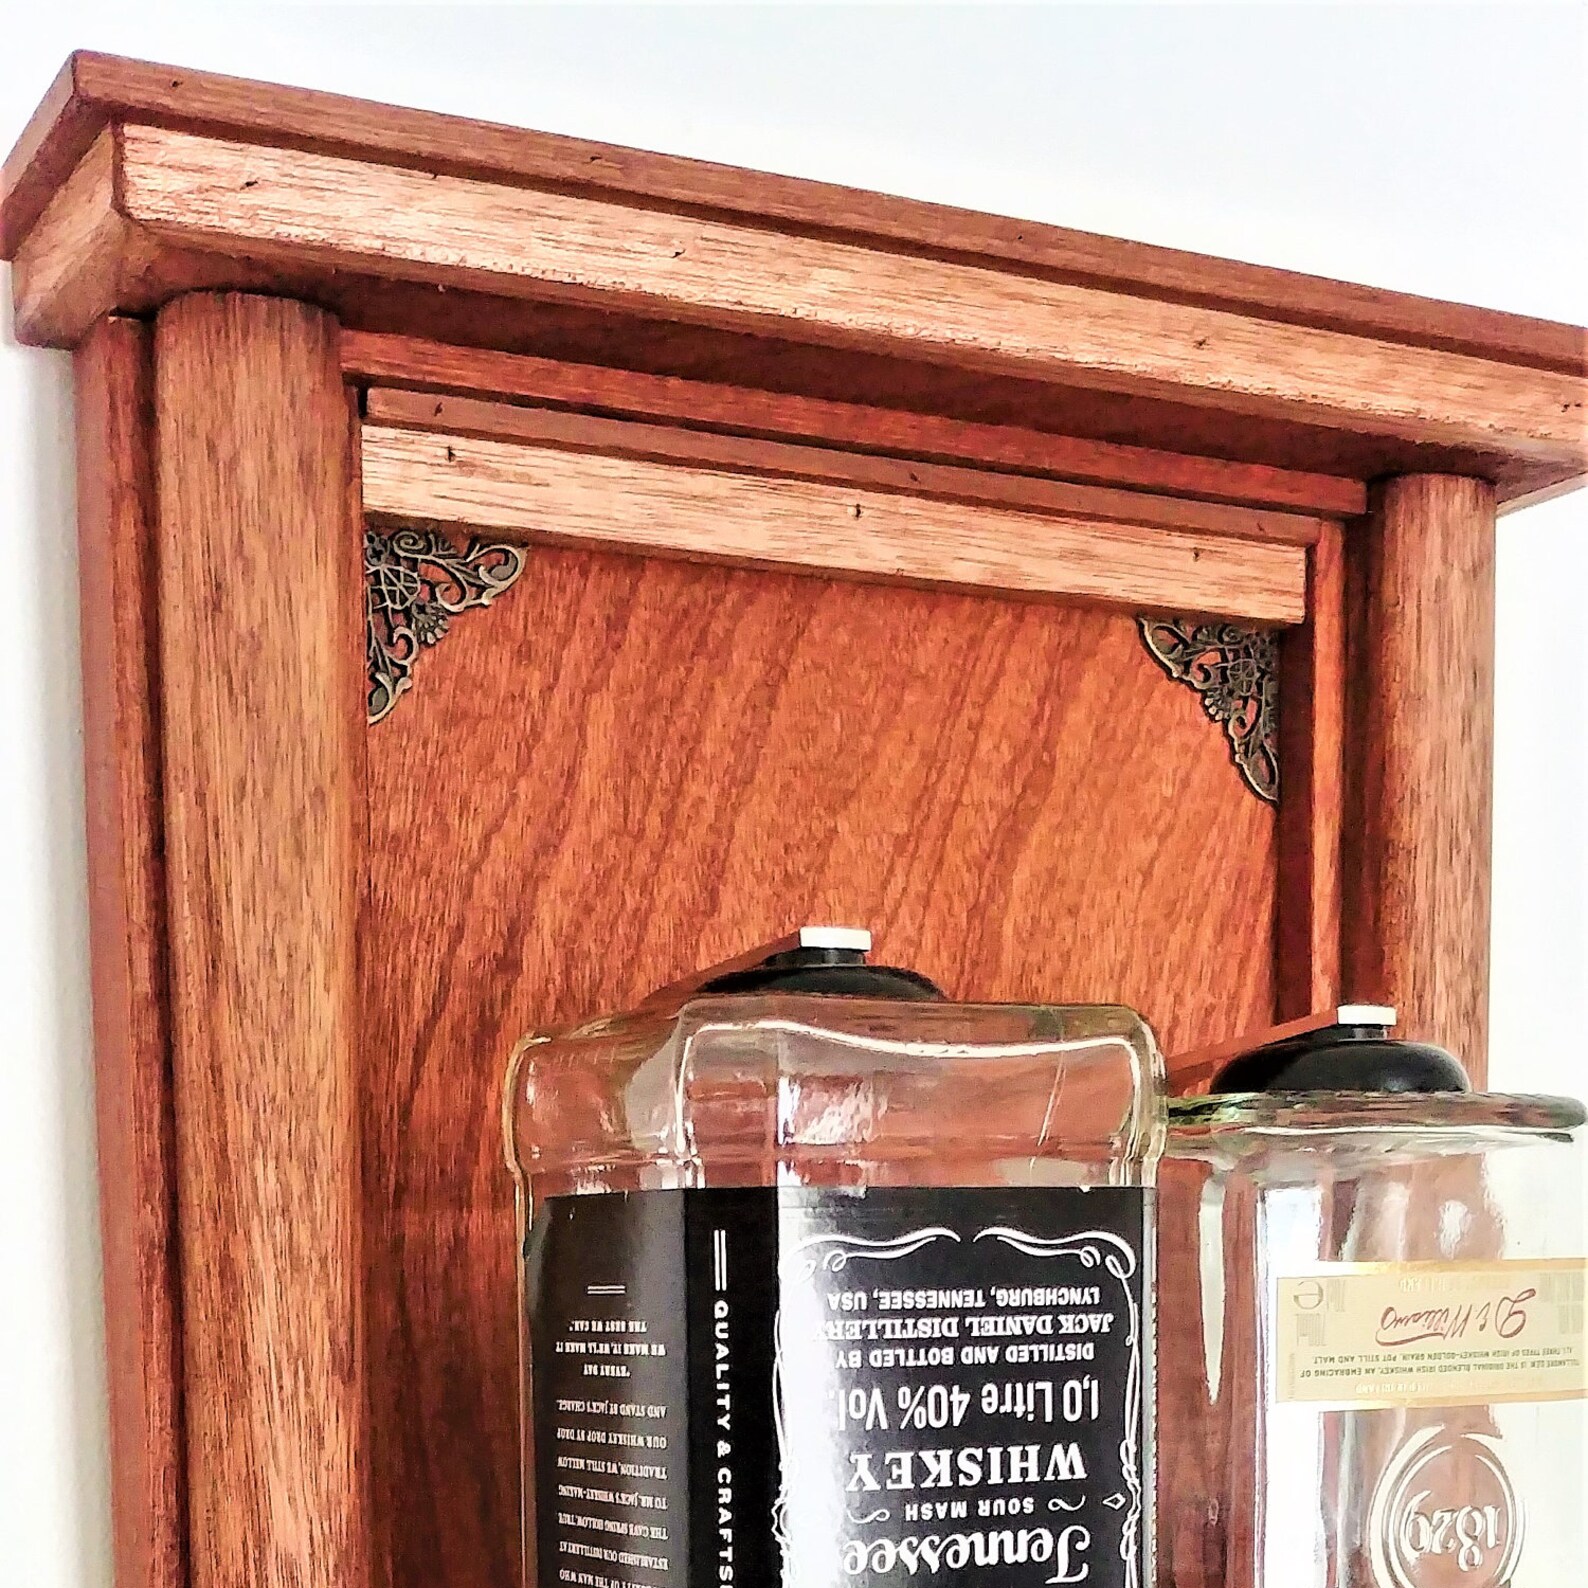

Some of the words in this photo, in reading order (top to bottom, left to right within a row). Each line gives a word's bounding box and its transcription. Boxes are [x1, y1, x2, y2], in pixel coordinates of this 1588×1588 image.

[826, 1291, 868, 1312] USA
[872, 1288, 986, 1310] TENNESSEE,
[989, 1285, 1101, 1308] LYNCHBURG,
[628, 1320, 647, 1333] THE
[812, 1317, 960, 1342] DISTILLERY
[964, 1314, 1054, 1337] DANIEL
[1056, 1312, 1115, 1335] JACK
[623, 1342, 649, 1356] MAKE
[650, 1343, 666, 1356] WE
[869, 1346, 955, 1368] BOTTLED
[960, 1344, 1000, 1366] AND
[1004, 1342, 1095, 1364] DISTILLED
[1358, 1354, 1380, 1363] STILL
[1382, 1354, 1397, 1362] POT
[713, 1299, 731, 1432] QUALITY
[835, 1349, 863, 1369] BY
[1337, 1355, 1355, 1364] AND
[583, 1363, 599, 1376] DAY
[1299, 1369, 1312, 1378] OF
[1314, 1367, 1362, 1377] EMBRACING
[1364, 1367, 1376, 1375] AN
[1416, 1365, 1436, 1374] IRISH
[897, 1384, 971, 1430] 40%
[980, 1379, 1053, 1423] Litre
[1062, 1374, 1100, 1422] 1,0
[619, 1403, 646, 1417] STAND
[647, 1404, 667, 1418] AND
[826, 1387, 888, 1432] Vol.
[586, 1429, 607, 1444] DROP
[608, 1432, 645, 1447] WHISKEY
[646, 1435, 667, 1449] OUR
[716, 1439, 732, 1458] &
[845, 1441, 1088, 1492] WHISKEY
[655, 1496, 667, 1510] TO
[904, 1501, 968, 1521] MASH
[977, 1496, 1035, 1518] SOUR
[649, 1526, 669, 1541] THE
[1400, 1490, 1501, 1572] 1829
[842, 1525, 1091, 1585] Tennessee
[578, 1572, 594, 1586] MAN
